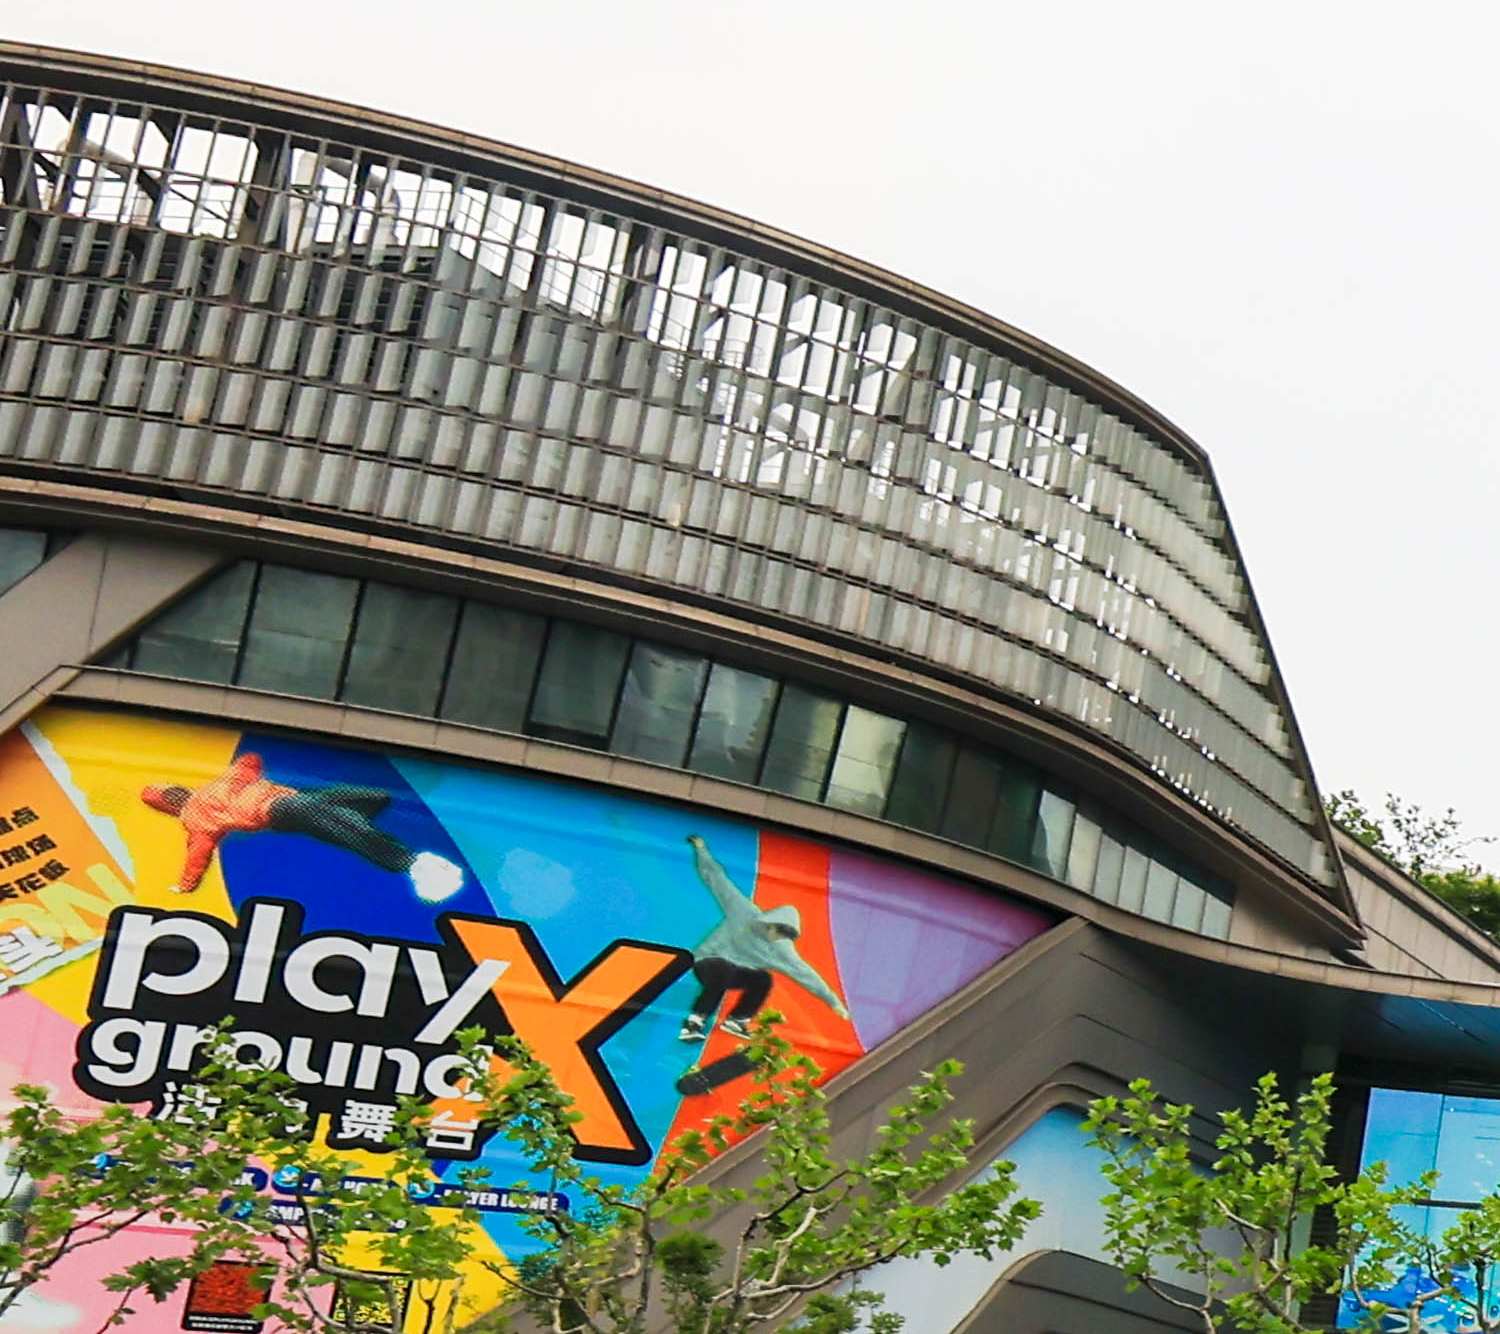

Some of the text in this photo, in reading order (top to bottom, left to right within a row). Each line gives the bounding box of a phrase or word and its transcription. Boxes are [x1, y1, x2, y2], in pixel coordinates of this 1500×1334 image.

[87, 1017, 494, 1102] ground
[102, 904, 683, 1153] play X
